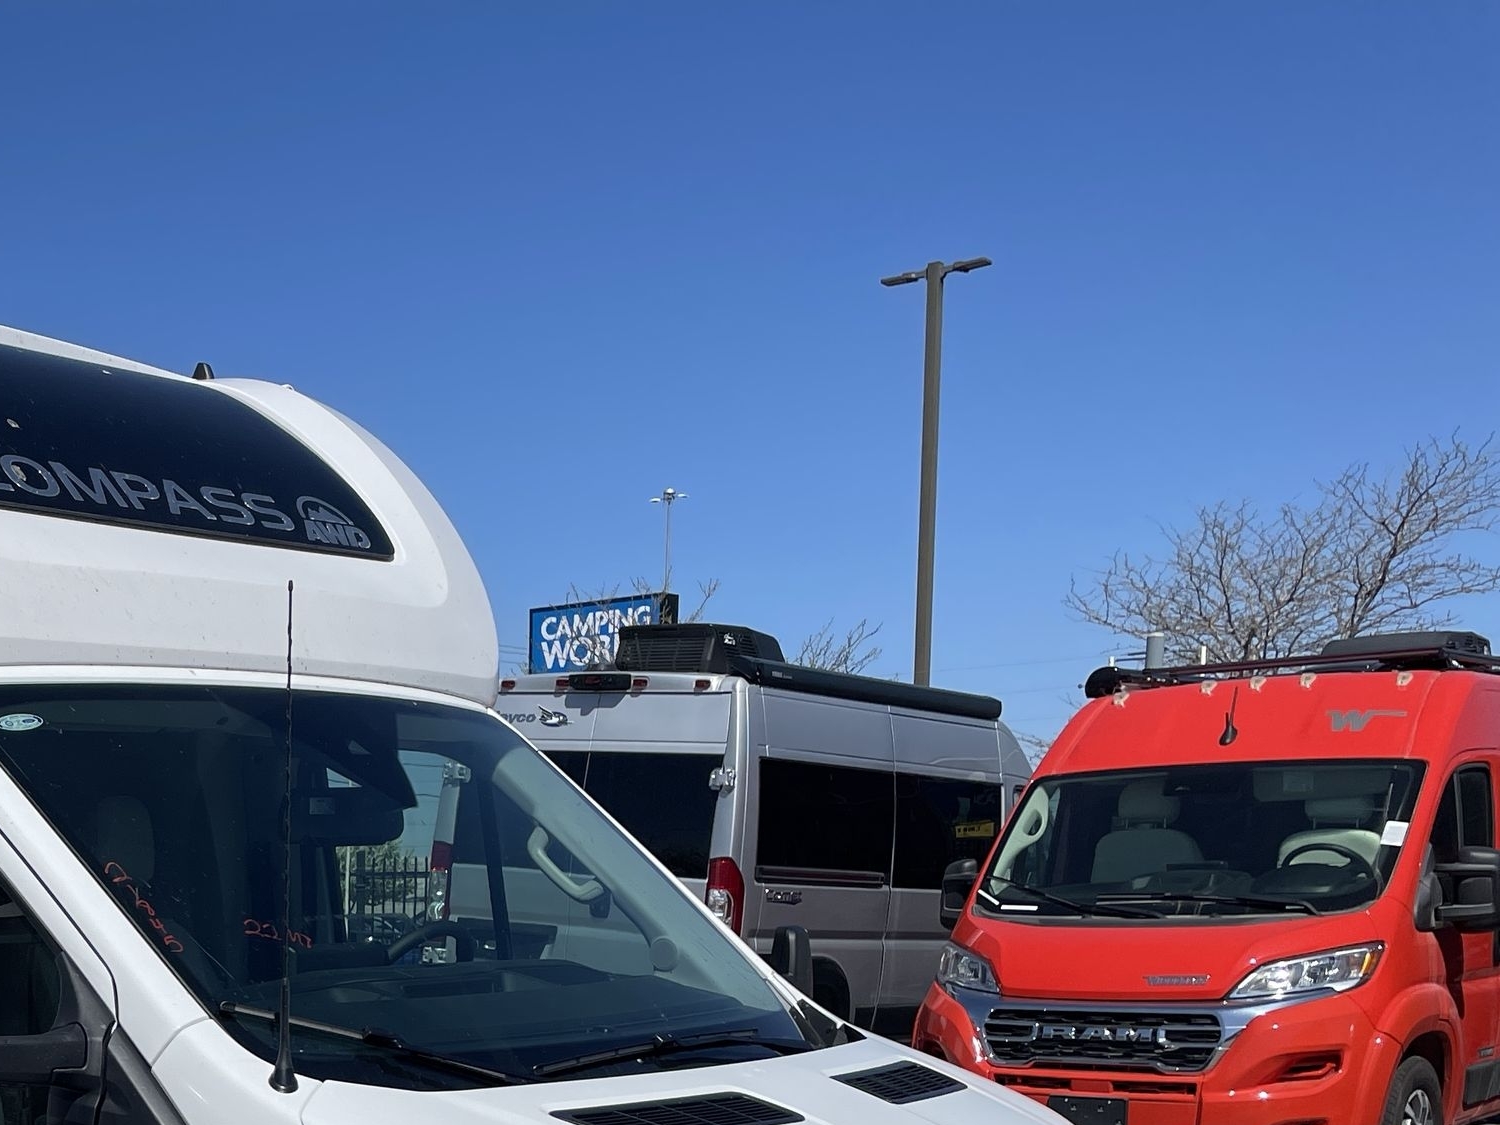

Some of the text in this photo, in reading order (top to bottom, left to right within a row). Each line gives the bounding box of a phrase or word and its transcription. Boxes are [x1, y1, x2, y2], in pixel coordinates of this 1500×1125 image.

[304, 519, 371, 549] AWD
[541, 605, 652, 641] CAMPING
[541, 633, 620, 670] WOR
[496, 711, 536, 724] ayco
[1041, 1025, 1154, 1043] RAM
